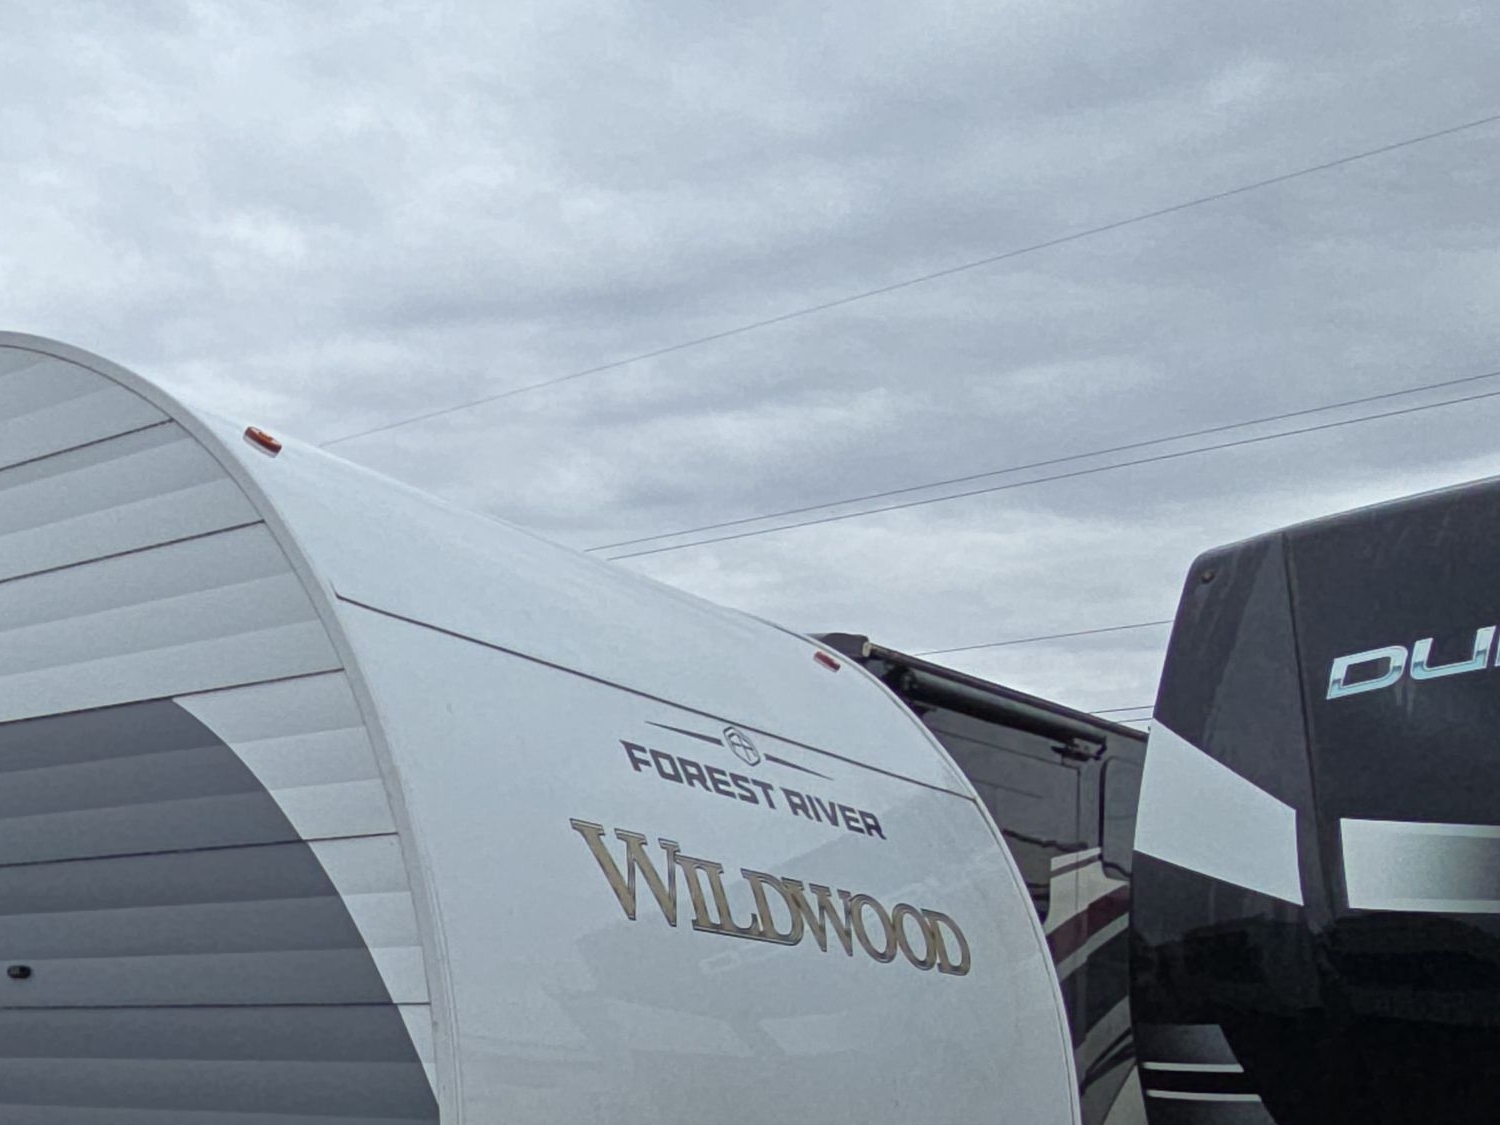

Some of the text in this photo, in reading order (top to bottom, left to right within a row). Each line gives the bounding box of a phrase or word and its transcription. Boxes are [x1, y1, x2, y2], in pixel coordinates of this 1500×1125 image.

[1326, 624, 1500, 700] DU
[619, 739, 888, 841] FOREST RIVER
[569, 817, 972, 977] WILDWOOD
